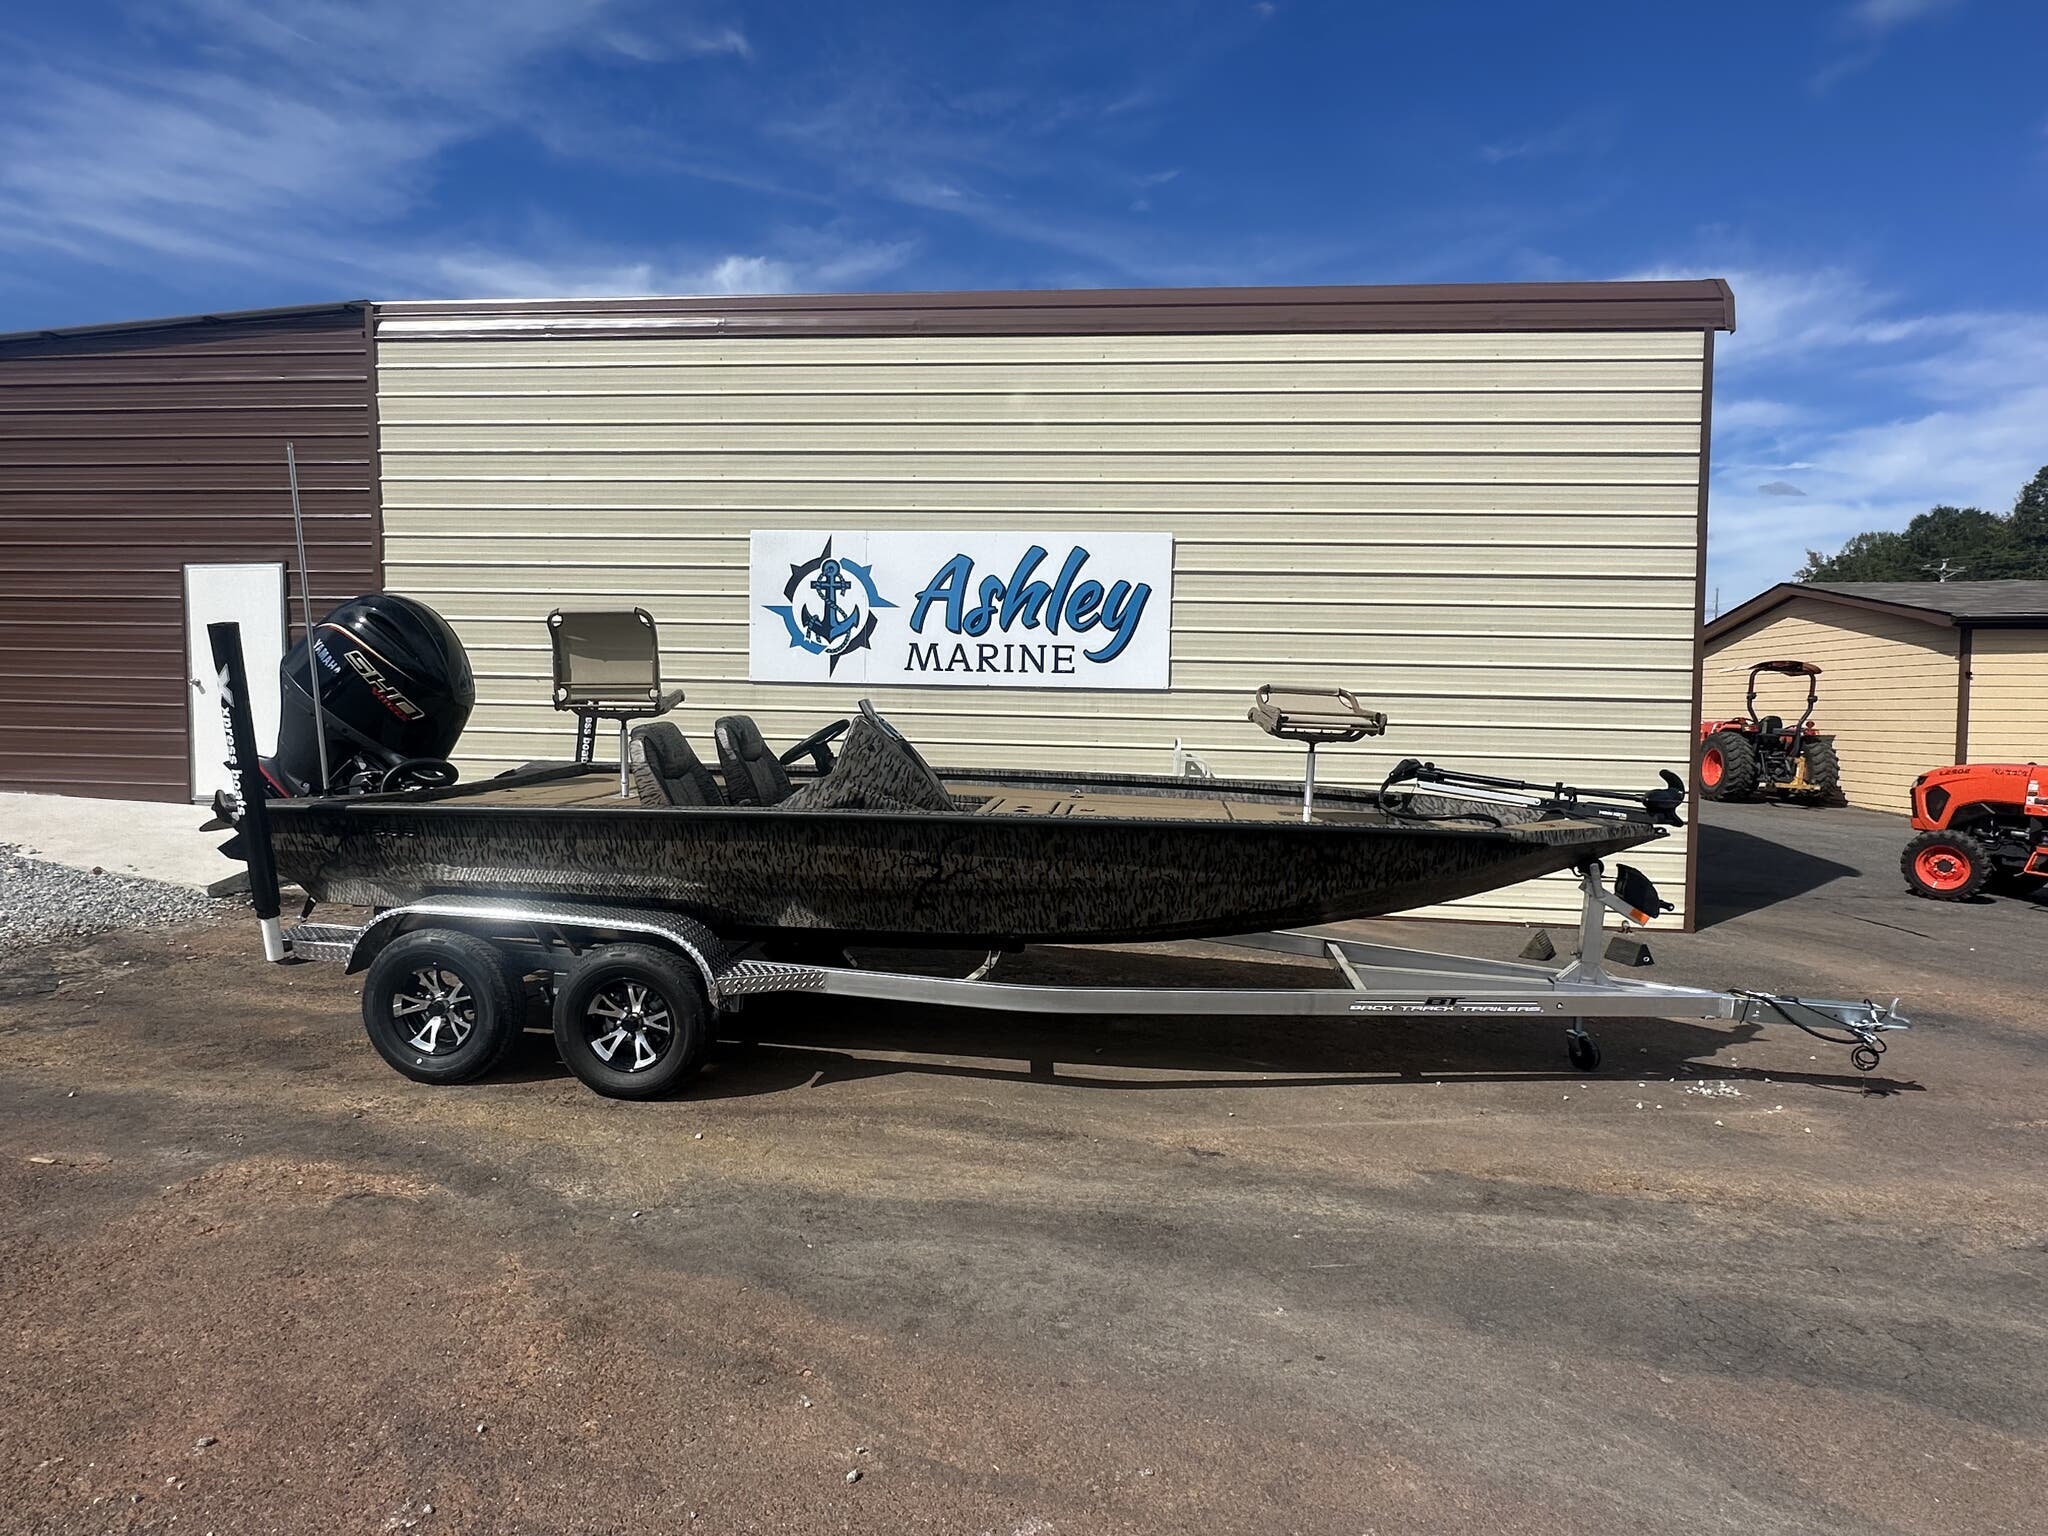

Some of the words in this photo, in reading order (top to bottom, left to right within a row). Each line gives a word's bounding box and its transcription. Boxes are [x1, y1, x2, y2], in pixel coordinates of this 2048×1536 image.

[911, 545, 1152, 663] Ashley
[313, 638, 342, 674] YAMAHA
[904, 643, 1075, 674] MARINE
[344, 650, 425, 720] SHO
[584, 716, 593, 735] ess
[221, 707, 237, 765] xpress
[231, 769, 247, 817] boats
[581, 737, 592, 763] boat
